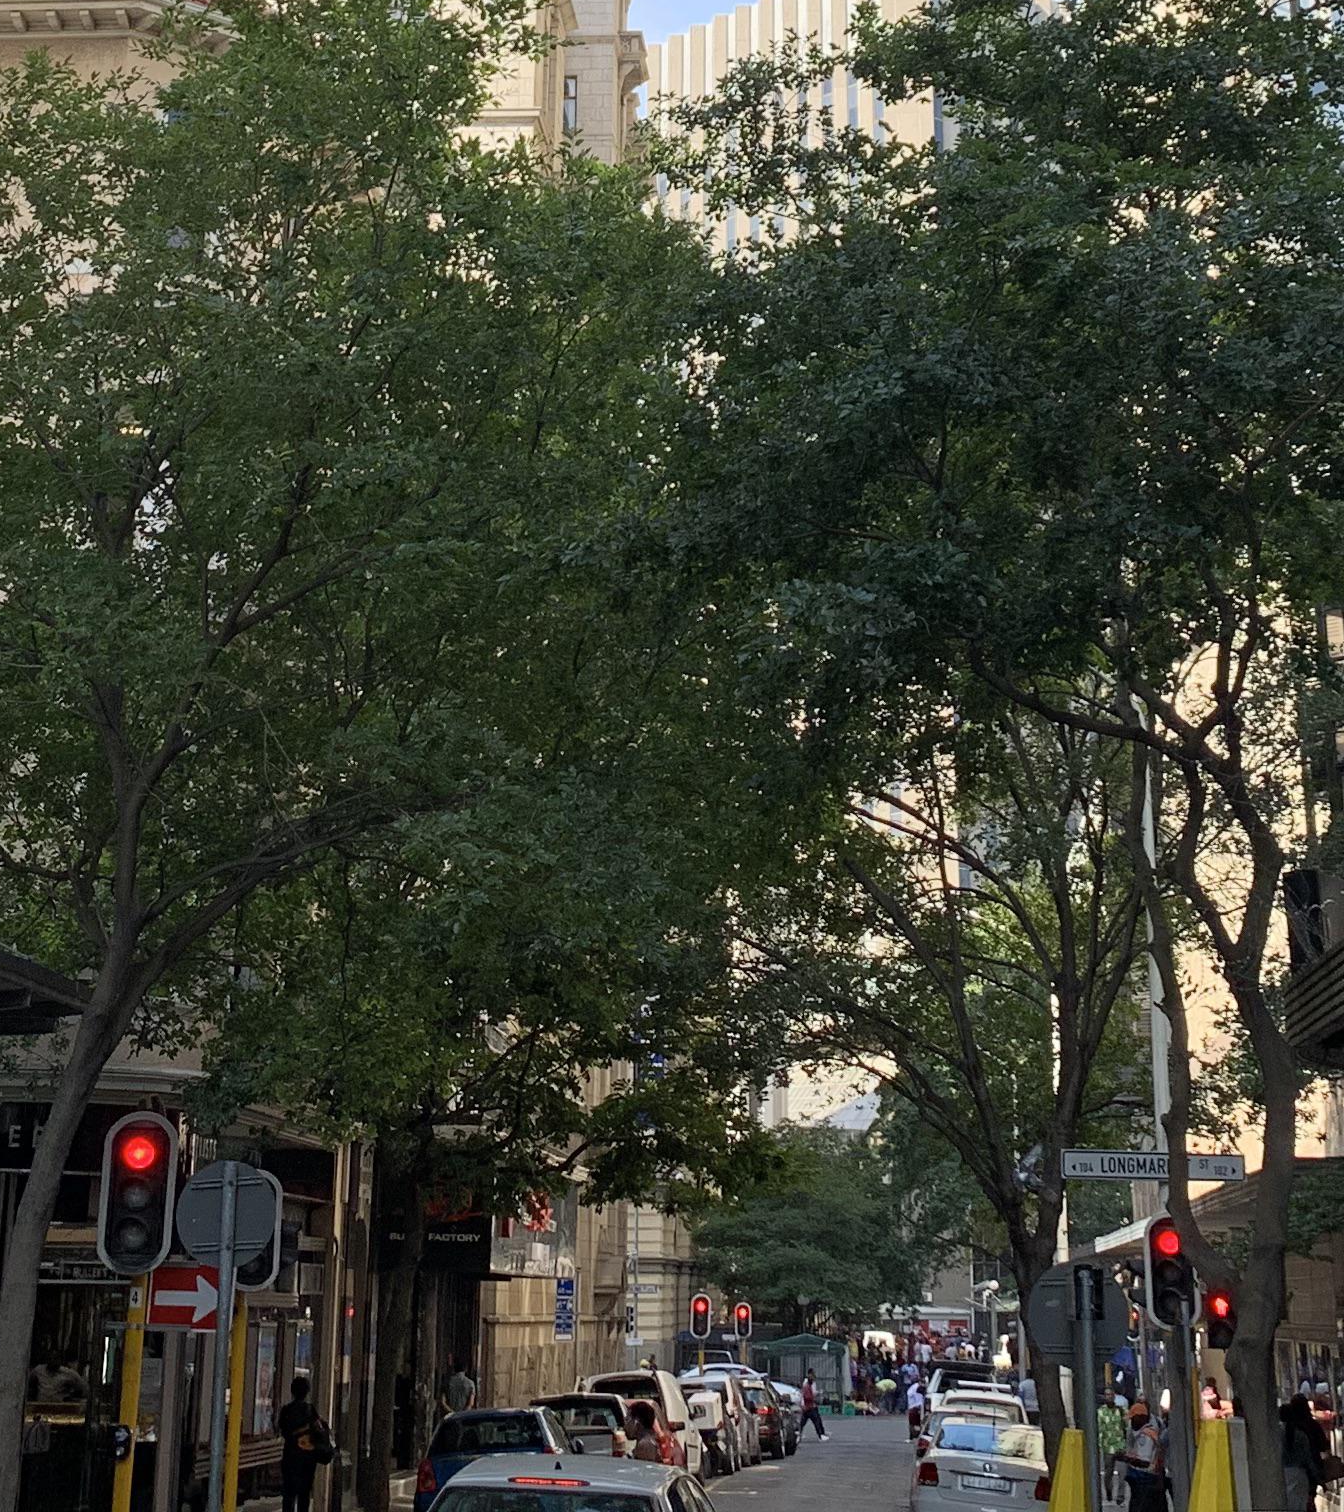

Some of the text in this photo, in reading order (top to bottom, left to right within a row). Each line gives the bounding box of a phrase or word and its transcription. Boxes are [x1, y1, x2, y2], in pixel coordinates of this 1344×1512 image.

[1100, 1156, 1187, 1175] LONGMAR
[1198, 1159, 1209, 1170] ST
[428, 1232, 481, 1242] FACTORY
[132, 1290, 139, 1304] 4
